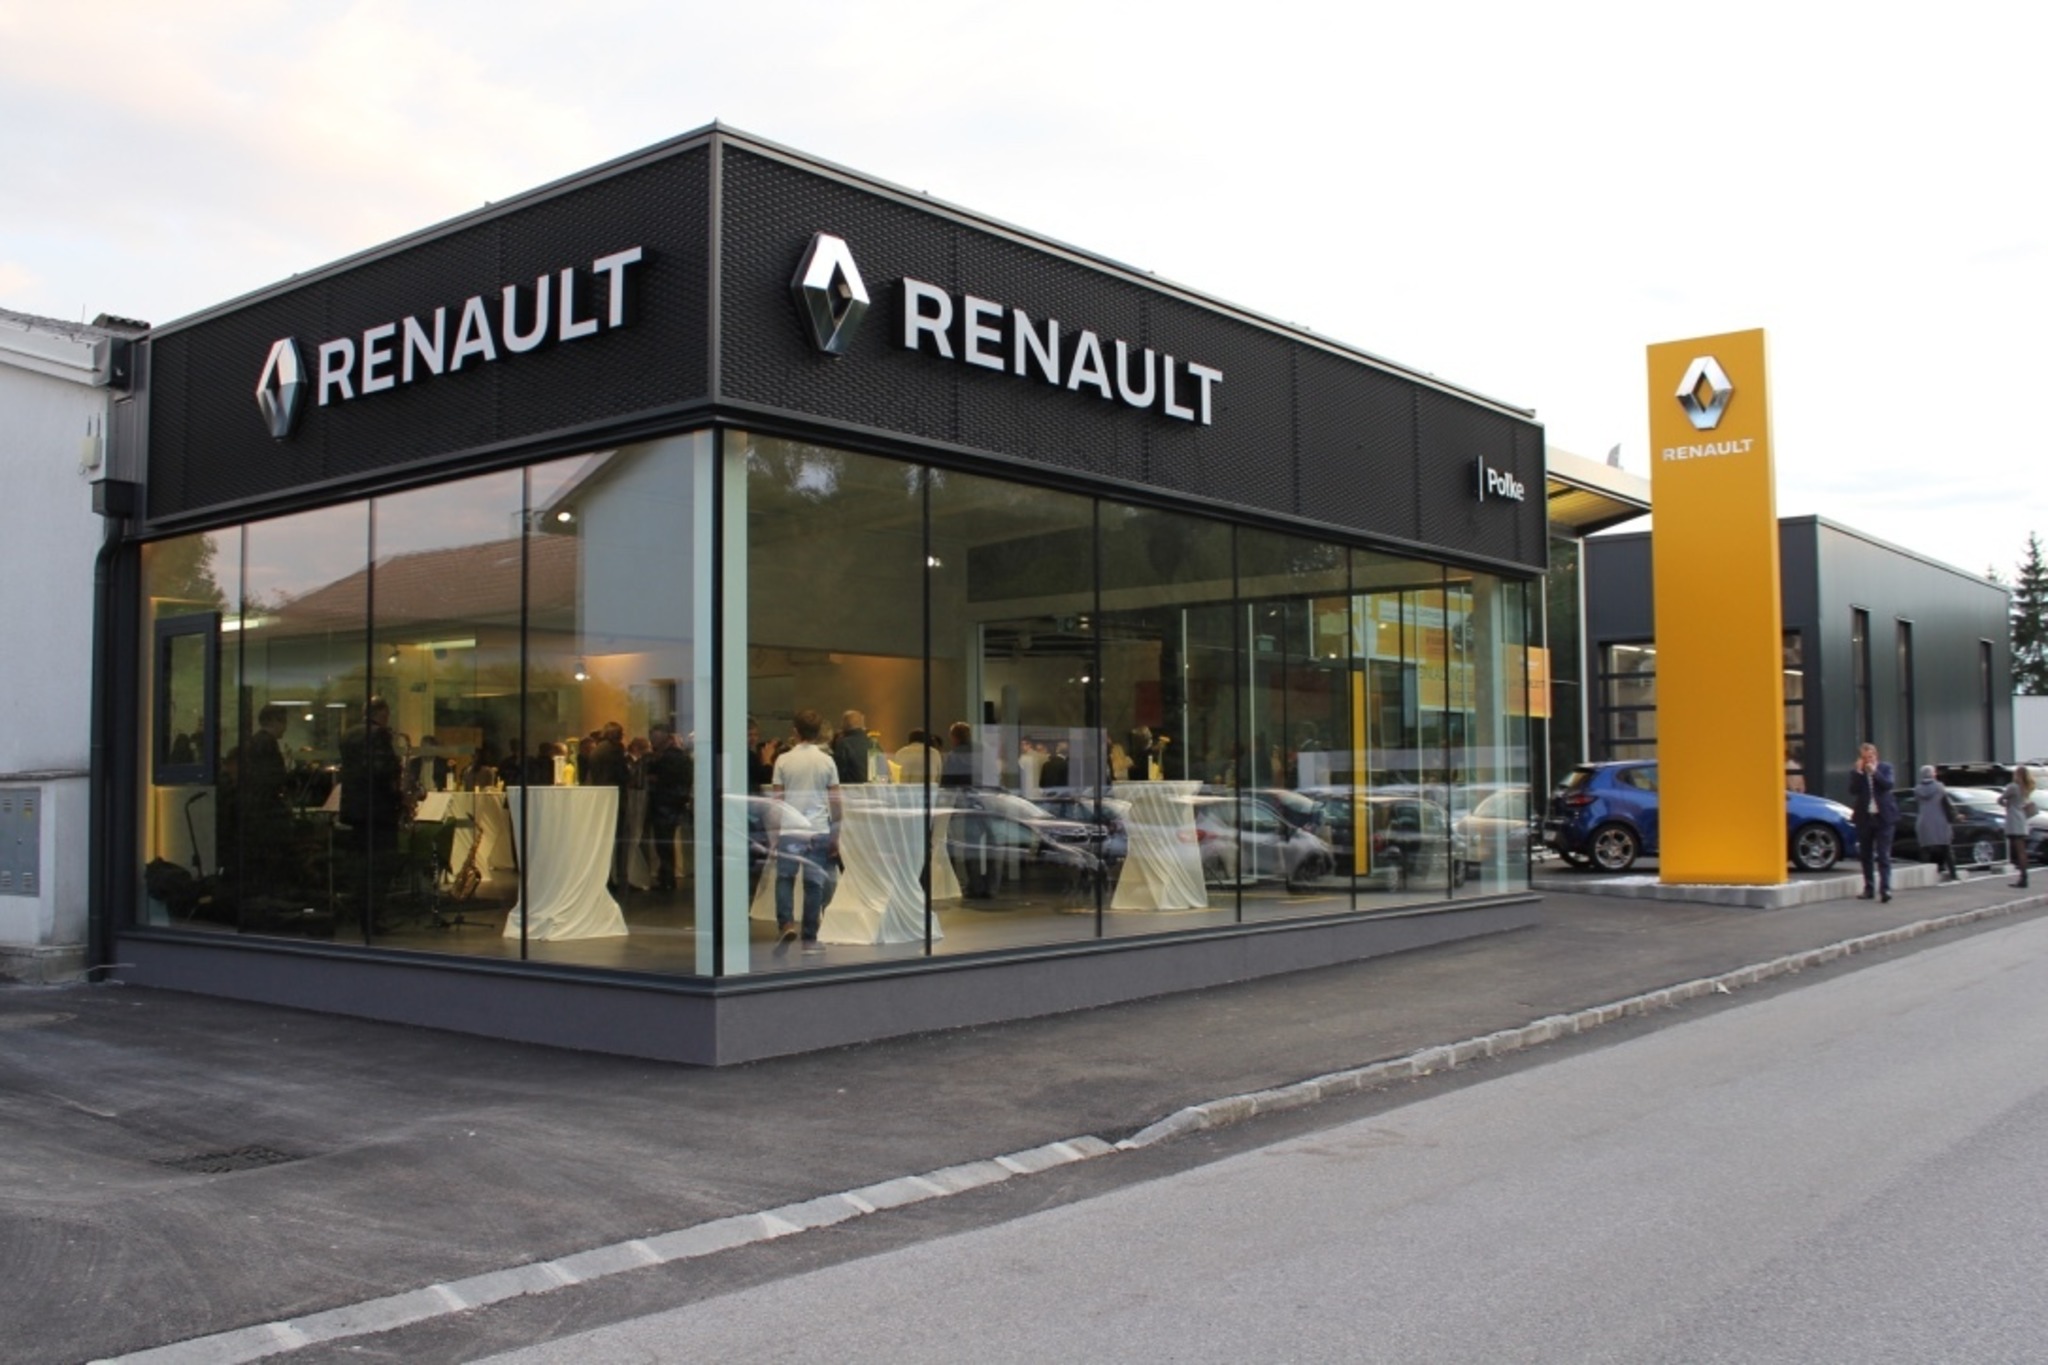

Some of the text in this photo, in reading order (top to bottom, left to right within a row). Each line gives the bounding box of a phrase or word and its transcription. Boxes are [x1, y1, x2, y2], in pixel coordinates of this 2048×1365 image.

[319, 247, 642, 406] RENAULT
[904, 278, 1223, 425] RENAULT
[1487, 467, 1525, 502] Polke
[1662, 438, 1754, 461] RENAULT
